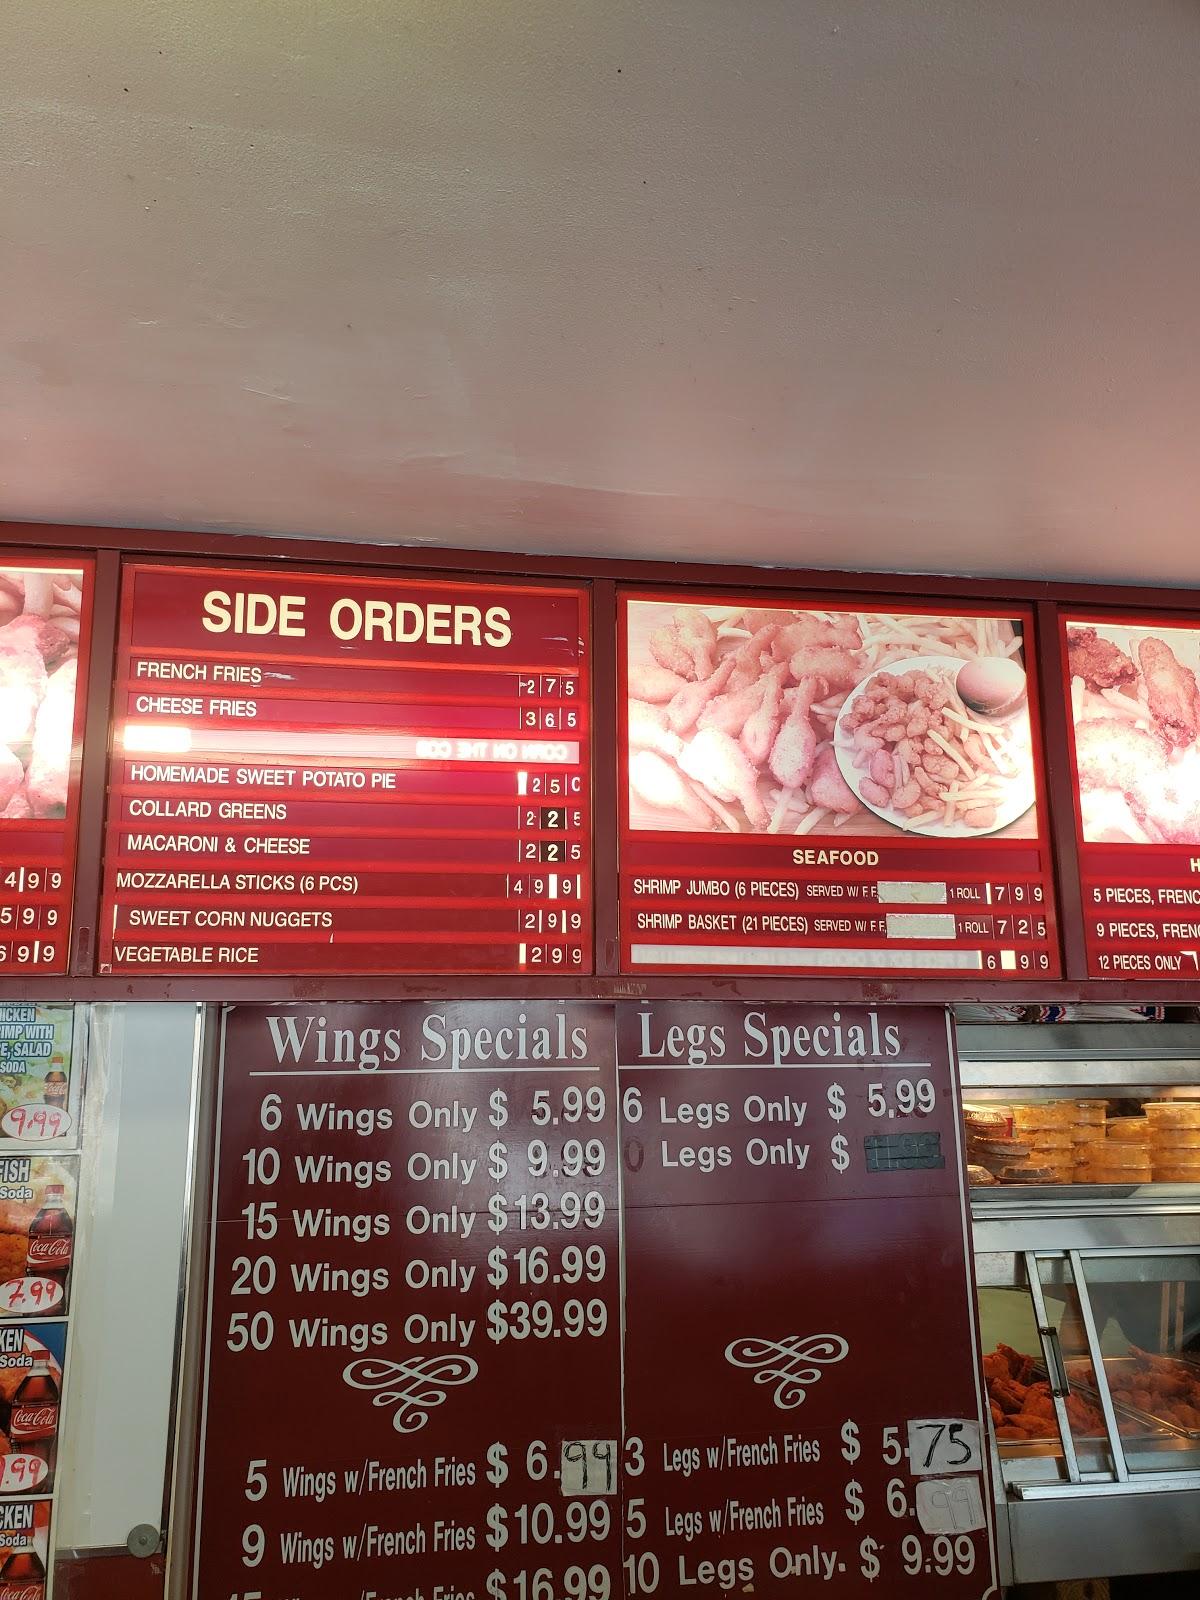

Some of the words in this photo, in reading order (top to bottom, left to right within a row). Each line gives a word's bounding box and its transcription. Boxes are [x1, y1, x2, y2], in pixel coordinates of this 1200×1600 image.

[202, 590, 306, 637] SIDE
[329, 598, 512, 648] ORDERS
[136, 662, 207, 680] FRENCH
[213, 665, 262, 683] FRIES
[136, 696, 203, 715] CHEESE
[209, 699, 257, 718] FRIES
[131, 765, 230, 784] HOMEMADE
[236, 768, 296, 786] SWEET
[302, 771, 366, 788] POTATO
[371, 772, 396, 789] PIE
[129, 800, 212, 818] COLLARD
[218, 803, 287, 820] GREENS
[127, 834, 218, 852] MACARONI
[224, 837, 236, 853] &
[244, 837, 310, 854] CHEESE
[792, 849, 879, 867] SEAFOOD
[116, 872, 231, 890] MOZZARELLA
[235, 874, 295, 891] STICKS
[299, 876, 315, 894] (6
[319, 876, 359, 895] PCS)
[633, 879, 681, 895] SHRIMP
[686, 880, 730, 896] JUMBO
[735, 881, 746, 899] (6
[750, 881, 799, 900] PIECES)
[806, 885, 843, 897] SERVED
[957, 888, 980, 899] ROLL
[1093, 888, 1102, 902] 5
[1105, 888, 1154, 905] PIECES,
[129, 909, 191, 926] SWEET
[195, 911, 245, 927] CORN
[250, 911, 333, 928] NUGGETS
[637, 913, 683, 929] SHRIMP
[688, 914, 737, 930] BASKET
[742, 915, 758, 934] (21
[762, 915, 808, 935] PIECES)
[814, 919, 851, 932] SERVED
[965, 922, 989, 934] ROLL
[1096, 923, 1104, 937] 9
[1109, 923, 1159, 940] PIECES,
[114, 946, 213, 963] VEGETABLE
[218, 947, 259, 964] RICE
[1098, 955, 1109, 970] 12
[1113, 955, 1151, 970] PIECES
[1155, 955, 1182, 970] ONLY
[0, 1024, 23, 1039] IMP
[25, 1024, 54, 1040] WITH
[266, 1014, 401, 1071] Wings
[420, 1013, 588, 1071] Specials
[638, 1012, 726, 1066] Legs
[744, 1011, 901, 1066] Specials
[0, 1042, 11, 1060] E,
[13, 1042, 51, 1057] SALAD
[0, 1061, 26, 1074] SODA
[260, 1093, 282, 1131] 6
[297, 1102, 393, 1136] Wings
[408, 1100, 477, 1132] Only
[531, 1086, 606, 1126] 5.99
[623, 1086, 643, 1123] 6
[660, 1096, 730, 1129] Legs
[744, 1095, 807, 1127] Only
[827, 1082, 846, 1123] $
[868, 1078, 936, 1119] 5.99
[10, 1108, 62, 1137] 9.99
[241, 1147, 280, 1185] 10
[294, 1154, 392, 1189] Wings
[407, 1152, 477, 1185] Only
[527, 1138, 606, 1178] 9.99
[661, 1140, 732, 1173] Legs
[746, 1137, 810, 1170] Only
[830, 1133, 850, 1175] $
[0, 1187, 33, 1200] Soda
[241, 1201, 278, 1240] 15
[292, 1207, 390, 1242] Wings
[405, 1205, 476, 1239] Only
[230, 1255, 277, 1295] 20
[290, 1262, 389, 1297] Wings
[405, 1258, 476, 1293] Only
[5, 1279, 57, 1308] 7.99
[226, 1310, 274, 1353] 50
[288, 1318, 388, 1353] Wings
[404, 1313, 476, 1347] Only
[486, 1299, 608, 1344] $39.99
[0, 1353, 33, 1368] Soda
[625, 1436, 645, 1476] 3
[663, 1442, 700, 1477] Legs
[706, 1435, 778, 1472] w/French
[784, 1434, 820, 1463] Fries
[841, 1418, 861, 1465] $
[244, 1459, 268, 1502] 5
[282, 1466, 336, 1503] Wings
[344, 1458, 427, 1496] w/French
[434, 1457, 476, 1487] Fries
[626, 1498, 647, 1539] 5
[665, 1506, 703, 1542] Legs
[709, 1498, 782, 1535] w/French
[787, 1496, 824, 1527] Fries
[844, 1479, 865, 1525] $
[0, 1533, 27, 1547] Soda
[241, 1524, 265, 1568] 9
[280, 1531, 334, 1570] Wings
[342, 1522, 426, 1562] w/French
[433, 1520, 476, 1552] Fries
[623, 1551, 660, 1594] 10
[679, 1555, 754, 1590] Legs
[901, 1534, 976, 1576] 9.99
